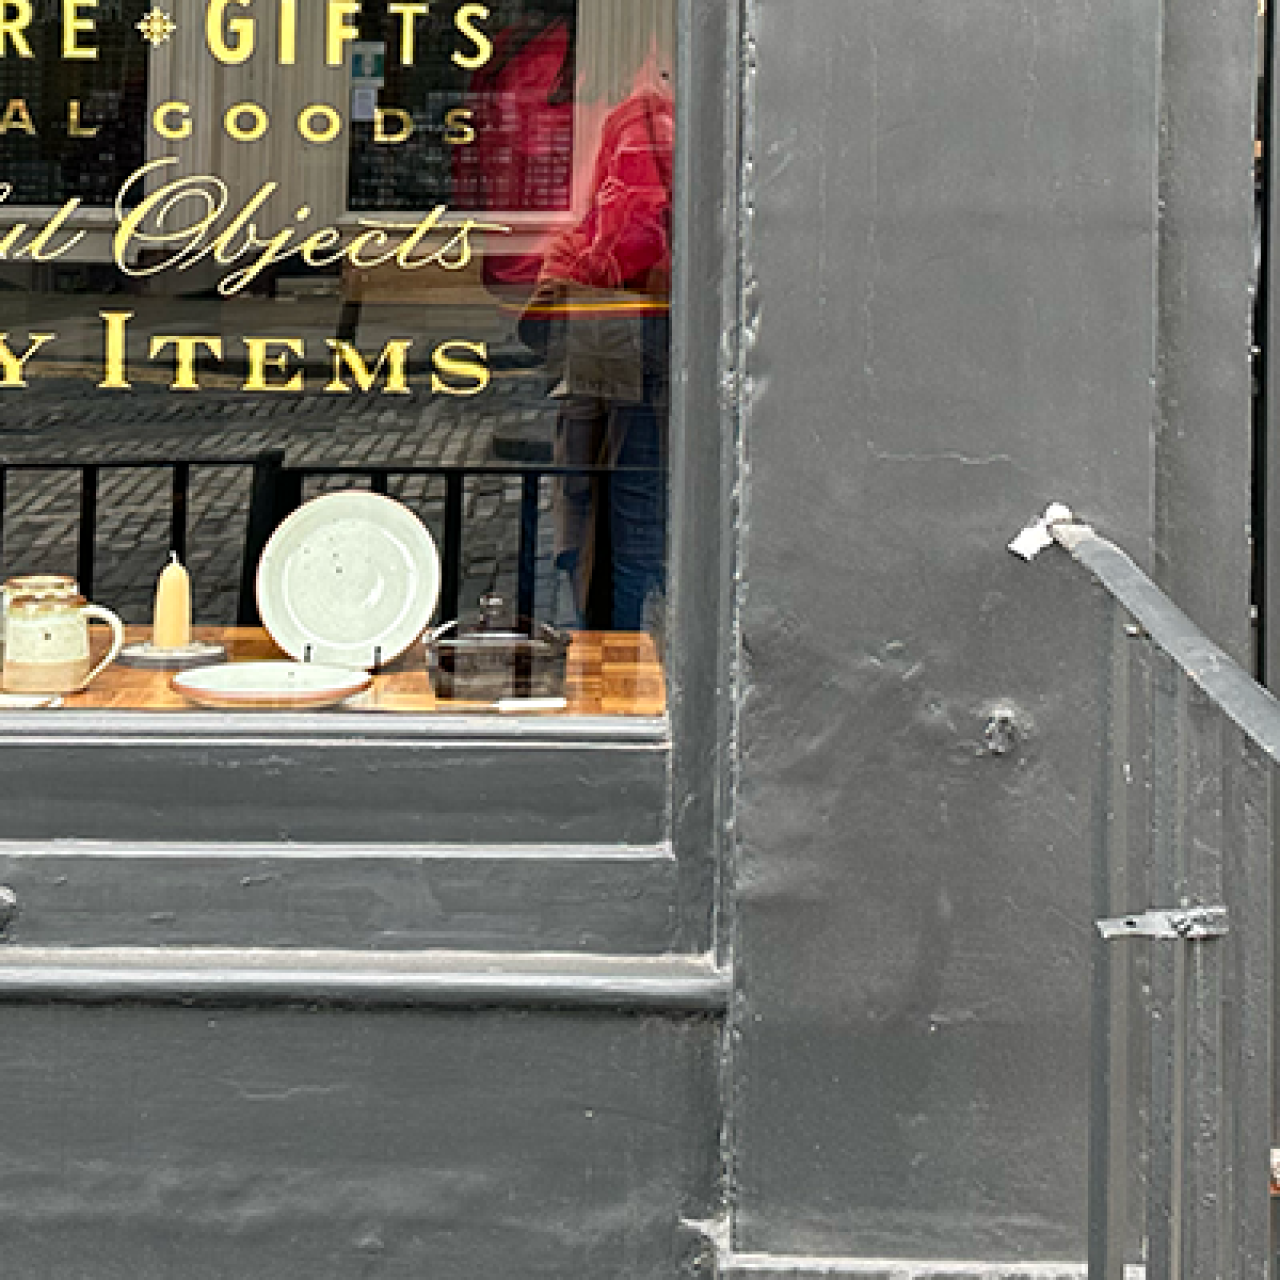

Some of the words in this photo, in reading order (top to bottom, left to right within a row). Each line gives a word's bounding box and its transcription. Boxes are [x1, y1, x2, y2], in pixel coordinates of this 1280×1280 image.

[151, 101, 477, 145] GOODS
[113, 156, 513, 296] Objects
[97, 311, 492, 396] ITEMS
